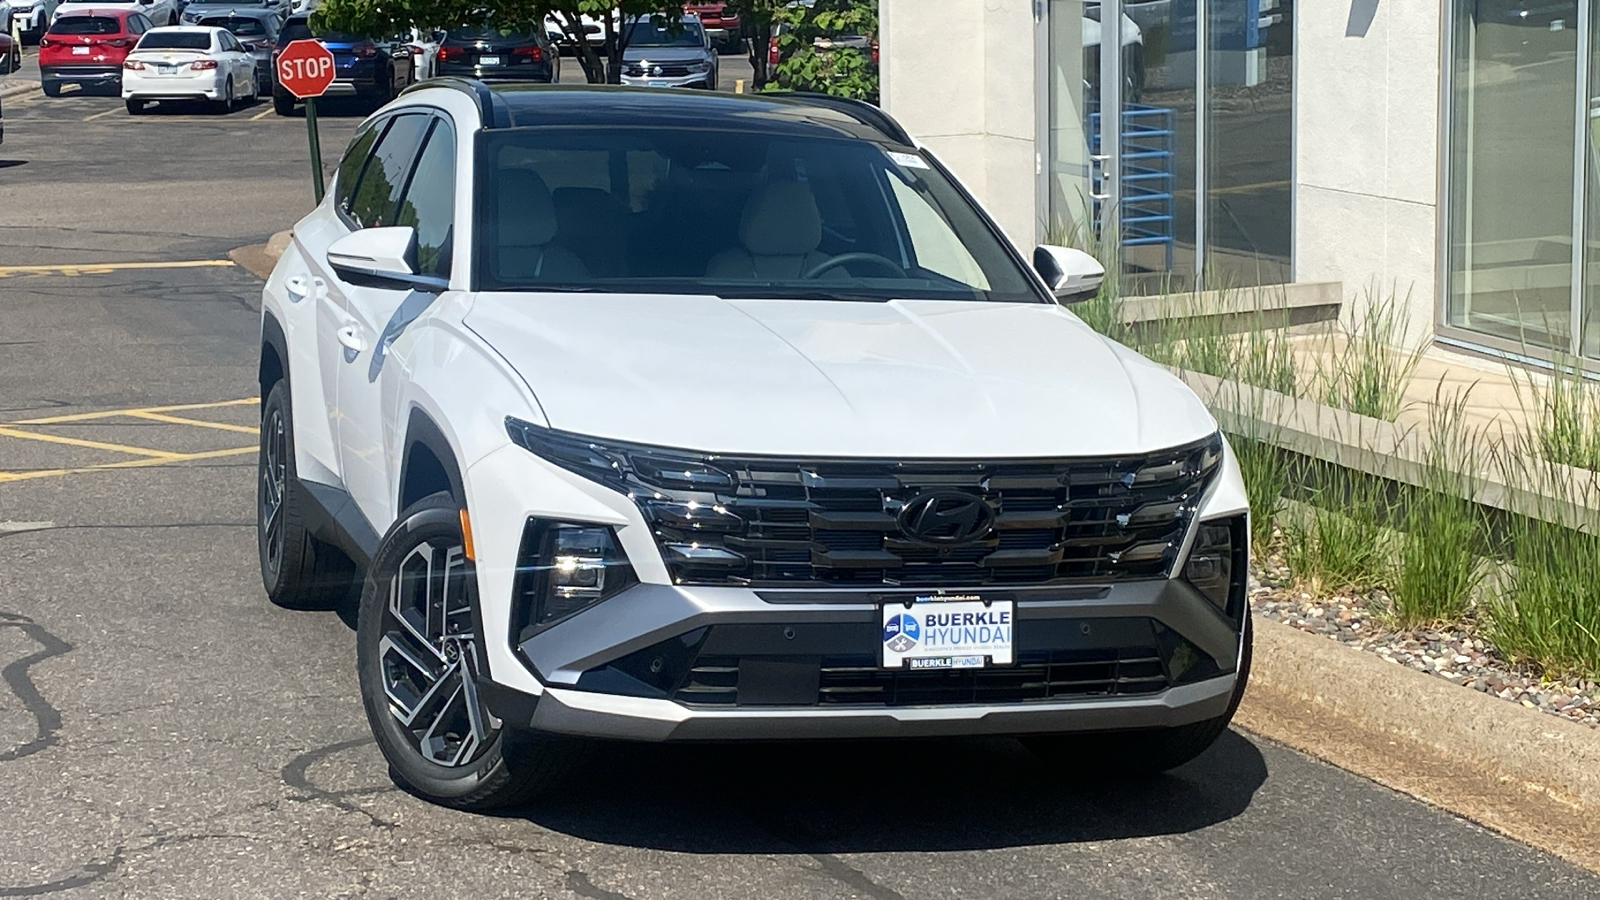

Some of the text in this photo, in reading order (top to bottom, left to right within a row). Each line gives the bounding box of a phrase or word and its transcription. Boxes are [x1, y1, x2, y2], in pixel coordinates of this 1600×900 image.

[281, 57, 331, 80] STOP
[925, 612, 1010, 627] BUERKLE
[924, 626, 1010, 645] HYUNDAI
[912, 657, 983, 667] BUERKLE HYUNDAI
